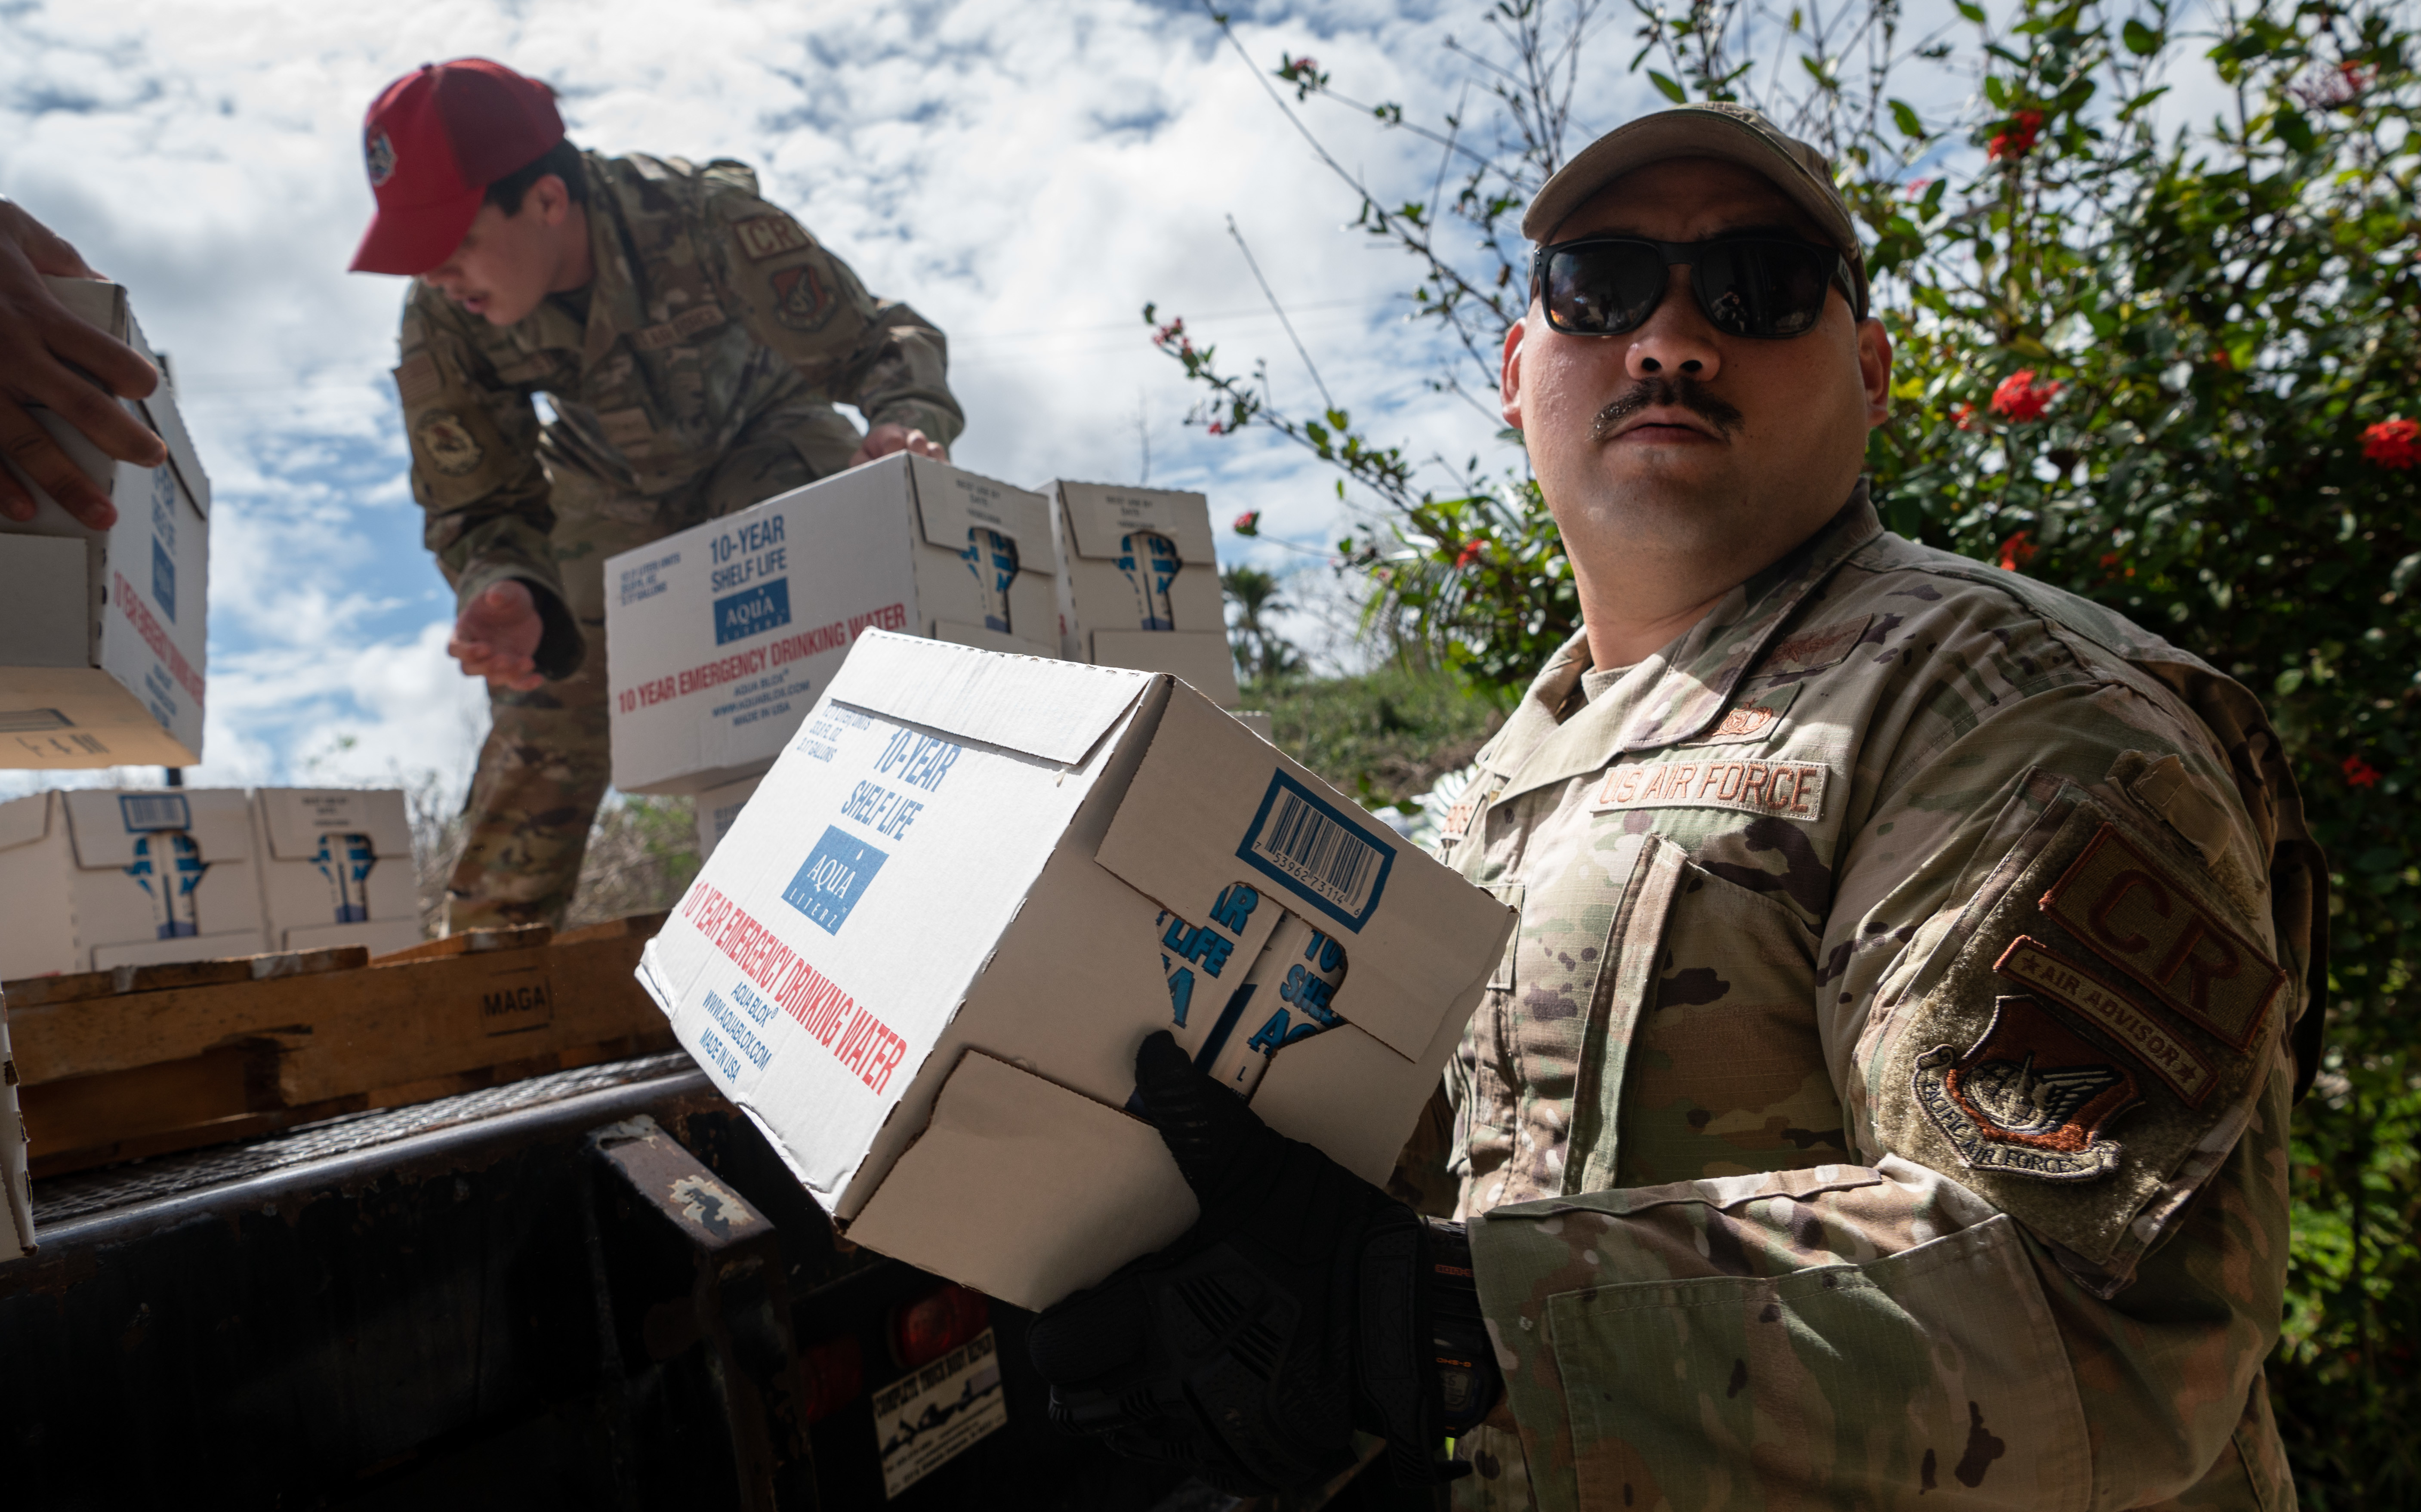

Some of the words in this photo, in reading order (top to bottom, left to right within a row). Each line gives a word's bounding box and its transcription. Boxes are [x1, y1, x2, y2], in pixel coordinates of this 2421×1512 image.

[747, 215, 795, 251] CR
[710, 514, 784, 565] 10-YEAR
[712, 560, 753, 593] SHELF
[756, 548, 787, 577] LIFE
[725, 596, 774, 627] AQUA
[618, 688, 636, 714] 10
[636, 675, 677, 707] YEAR
[678, 647, 767, 696] EMERGENCY
[770, 626, 847, 667] DRINKING
[873, 728, 962, 793] 10-YEAR
[1642, 764, 1697, 799] AIR
[1697, 762, 1817, 813] FORCE
[841, 780, 896, 826] SHELF
[876, 795, 925, 841] LIFE
[682, 879, 709, 918] 10
[807, 854, 856, 899] AQUA
[1254, 841, 1262, 850] 7
[1354, 907, 1361, 916] 6
[692, 887, 733, 941] YEAR
[789, 887, 838, 928] LITERZ
[715, 907, 796, 994] EMERGENCY
[1161, 917, 1235, 979] LIFE
[2087, 867, 2240, 1016] CR
[483, 987, 546, 1018] MAGA
[731, 981, 755, 1011] AQUA
[774, 958, 854, 1049] DRINKING
[2039, 965, 2080, 996] AIR
[2083, 991, 2180, 1067] ADVISOR
[699, 1027, 723, 1060] MADE
[716, 1046, 730, 1069] IN
[723, 1054, 741, 1084] USA
[703, 989, 773, 1072] WWW.AQUABLOX.COM
[833, 1006, 907, 1096] WATER
[1922, 1081, 1970, 1138] PACIFIC
[1960, 1139, 1997, 1164] AIR
[2005, 1148, 2082, 1174] FORCES
